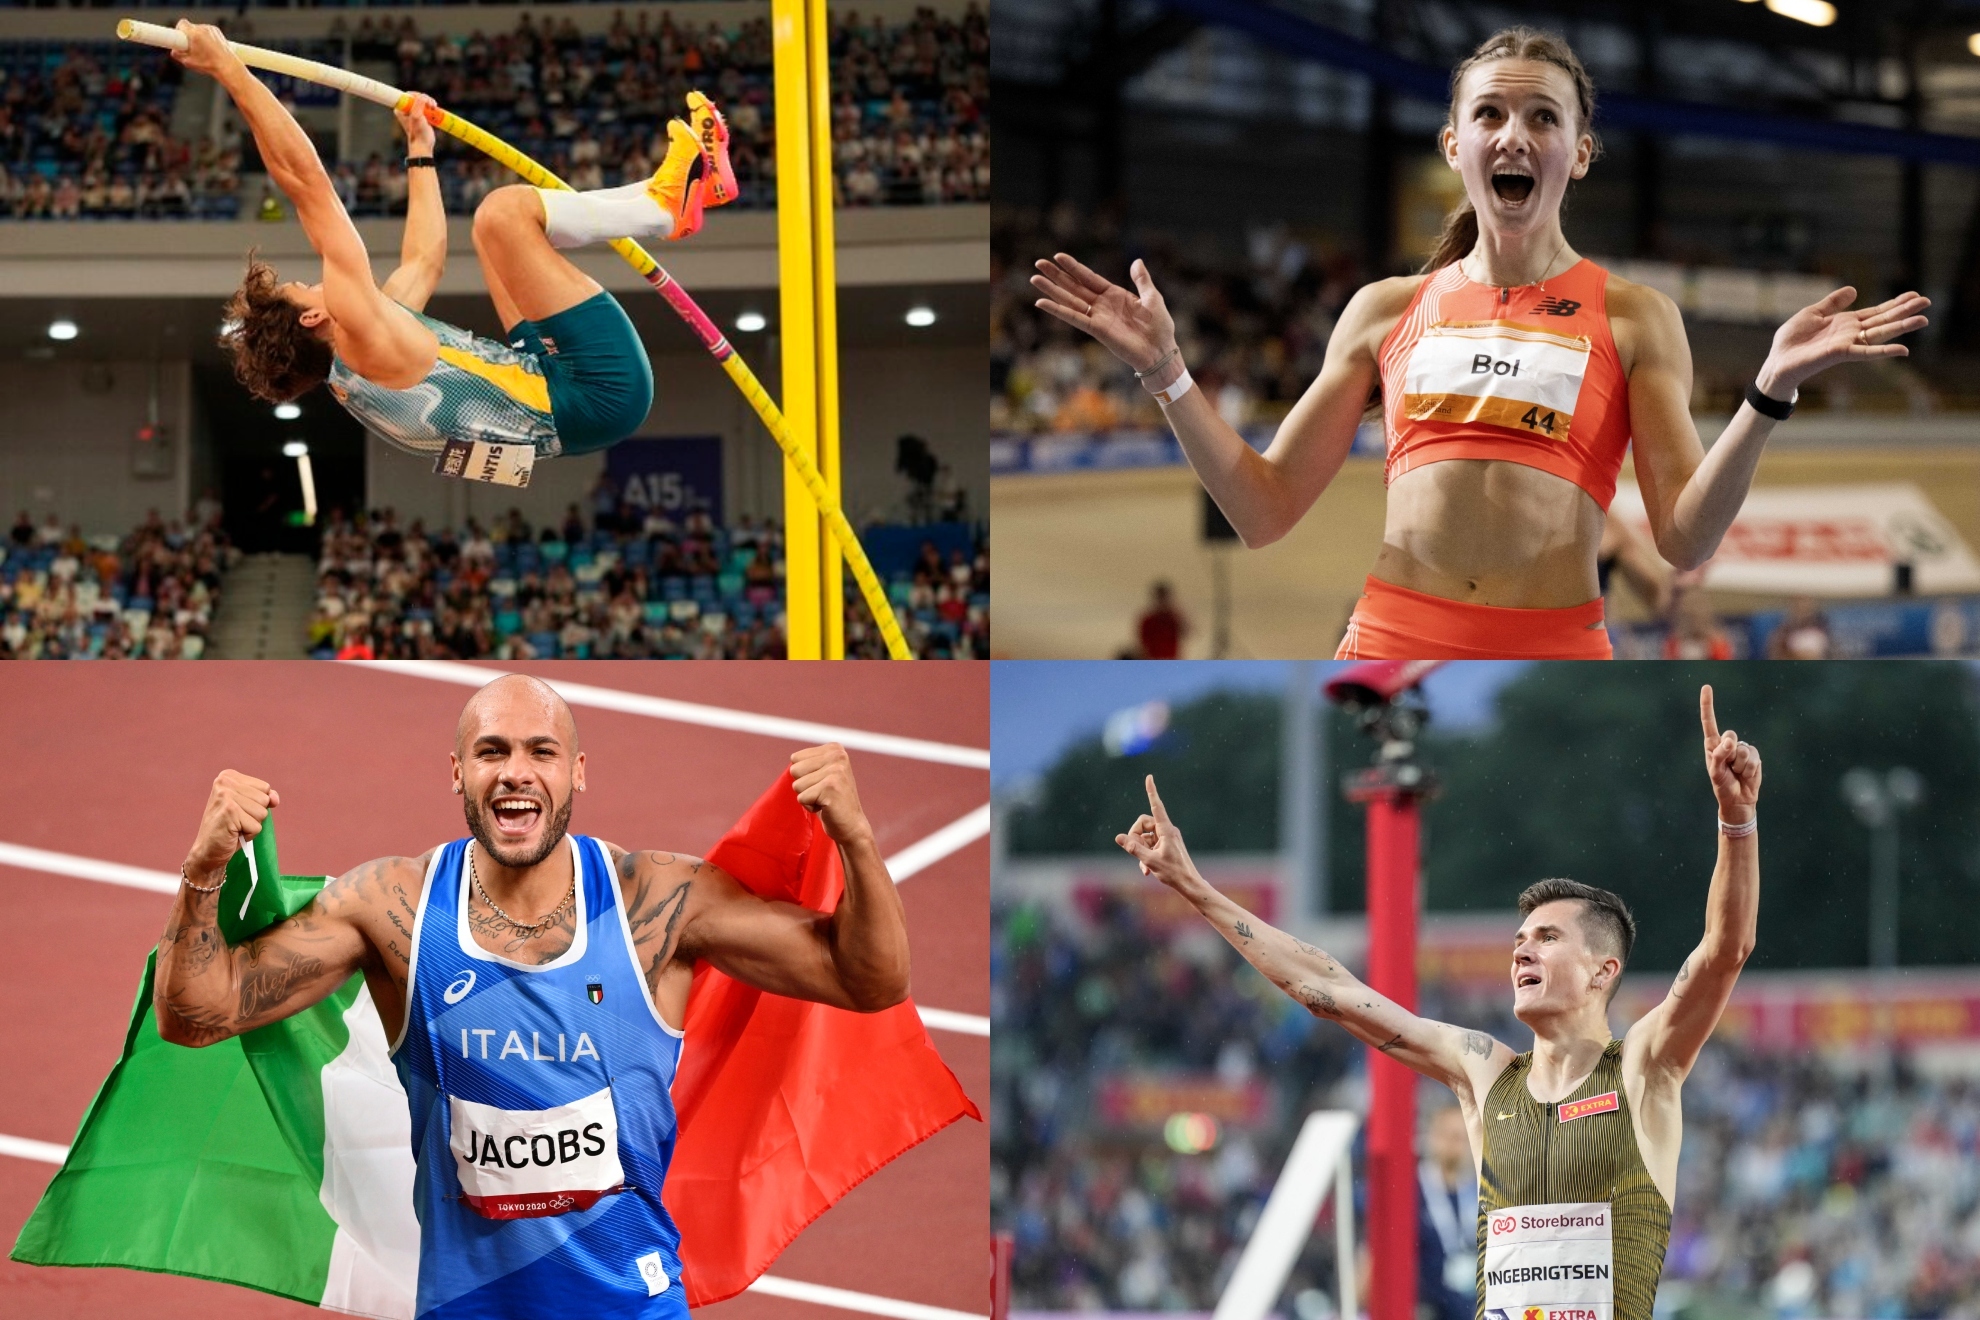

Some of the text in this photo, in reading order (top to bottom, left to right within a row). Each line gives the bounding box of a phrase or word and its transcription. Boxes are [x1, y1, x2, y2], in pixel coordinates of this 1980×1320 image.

[1471, 353, 1521, 377] Bol
[1521, 406, 1556, 434] 44
[623, 472, 683, 511] A15
[239, 951, 324, 1020] Meghan
[461, 1028, 600, 1062] ITALIA
[1580, 1098, 1613, 1112] EXTRA
[463, 1122, 606, 1169] JACOBS
[497, 1202, 547, 1212] TOKYO 2020
[1521, 1213, 1604, 1230] Storebrand
[1488, 1264, 1609, 1286] INGEBRIGTSEN
[1549, 1309, 1597, 1320] EXTRA
